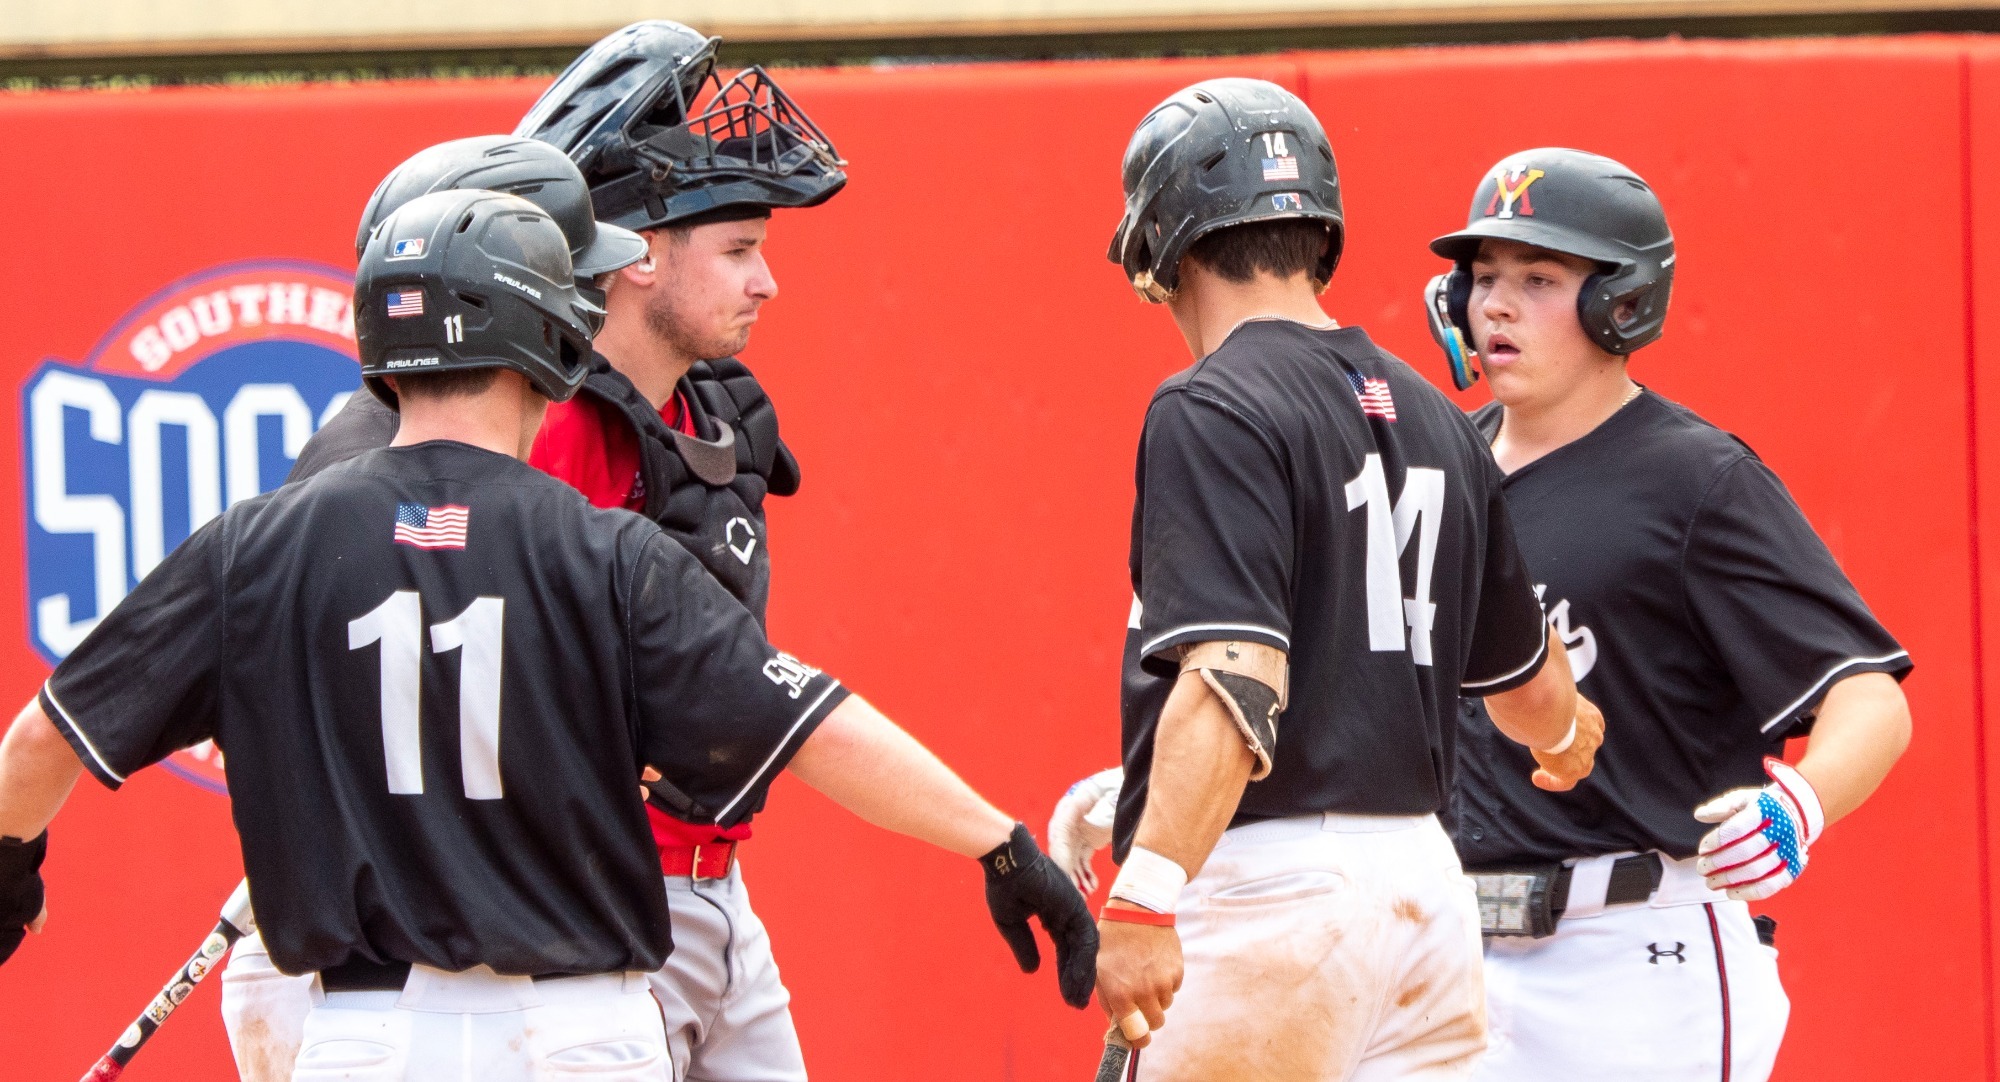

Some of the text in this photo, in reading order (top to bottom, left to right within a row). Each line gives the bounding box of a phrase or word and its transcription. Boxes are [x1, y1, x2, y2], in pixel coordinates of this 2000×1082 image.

[1262, 131, 1288, 158] 14
[494, 272, 542, 300] RAWLINGS
[130, 282, 354, 372] SOUTHE
[443, 314, 463, 344] 11
[386, 356, 440, 370] RAWLINGS
[1344, 453, 1446, 667] 14
[347, 590, 505, 801] 11
